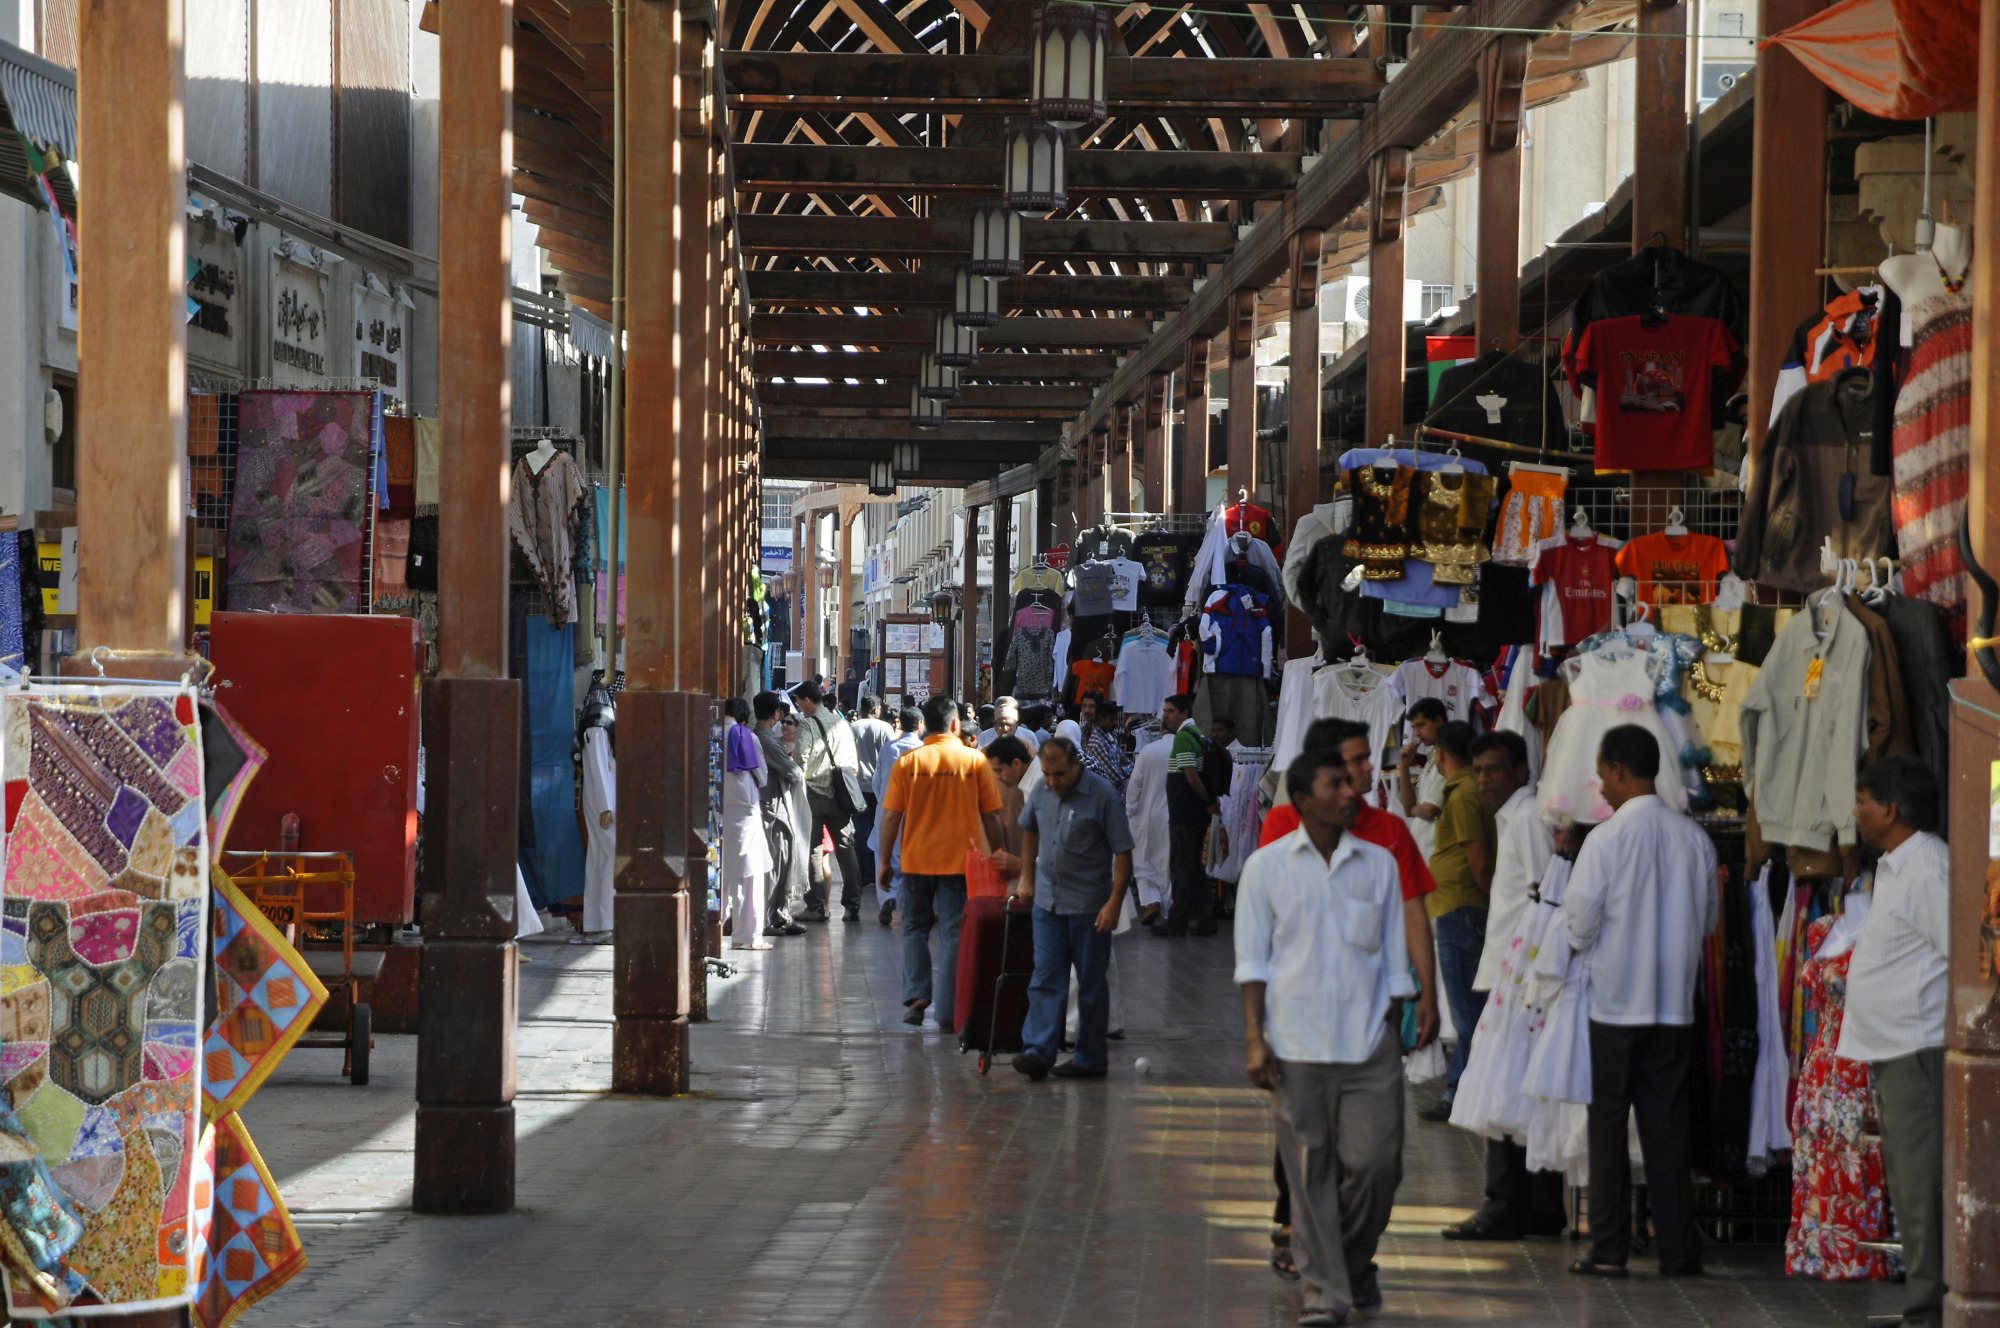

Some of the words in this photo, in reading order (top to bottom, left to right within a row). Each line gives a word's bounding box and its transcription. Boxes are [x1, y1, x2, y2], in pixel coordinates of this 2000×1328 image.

[1621, 351, 1684, 362] DUBAI
[1652, 559, 1699, 572] DUBAI
[1564, 586, 1607, 598] Emirates
